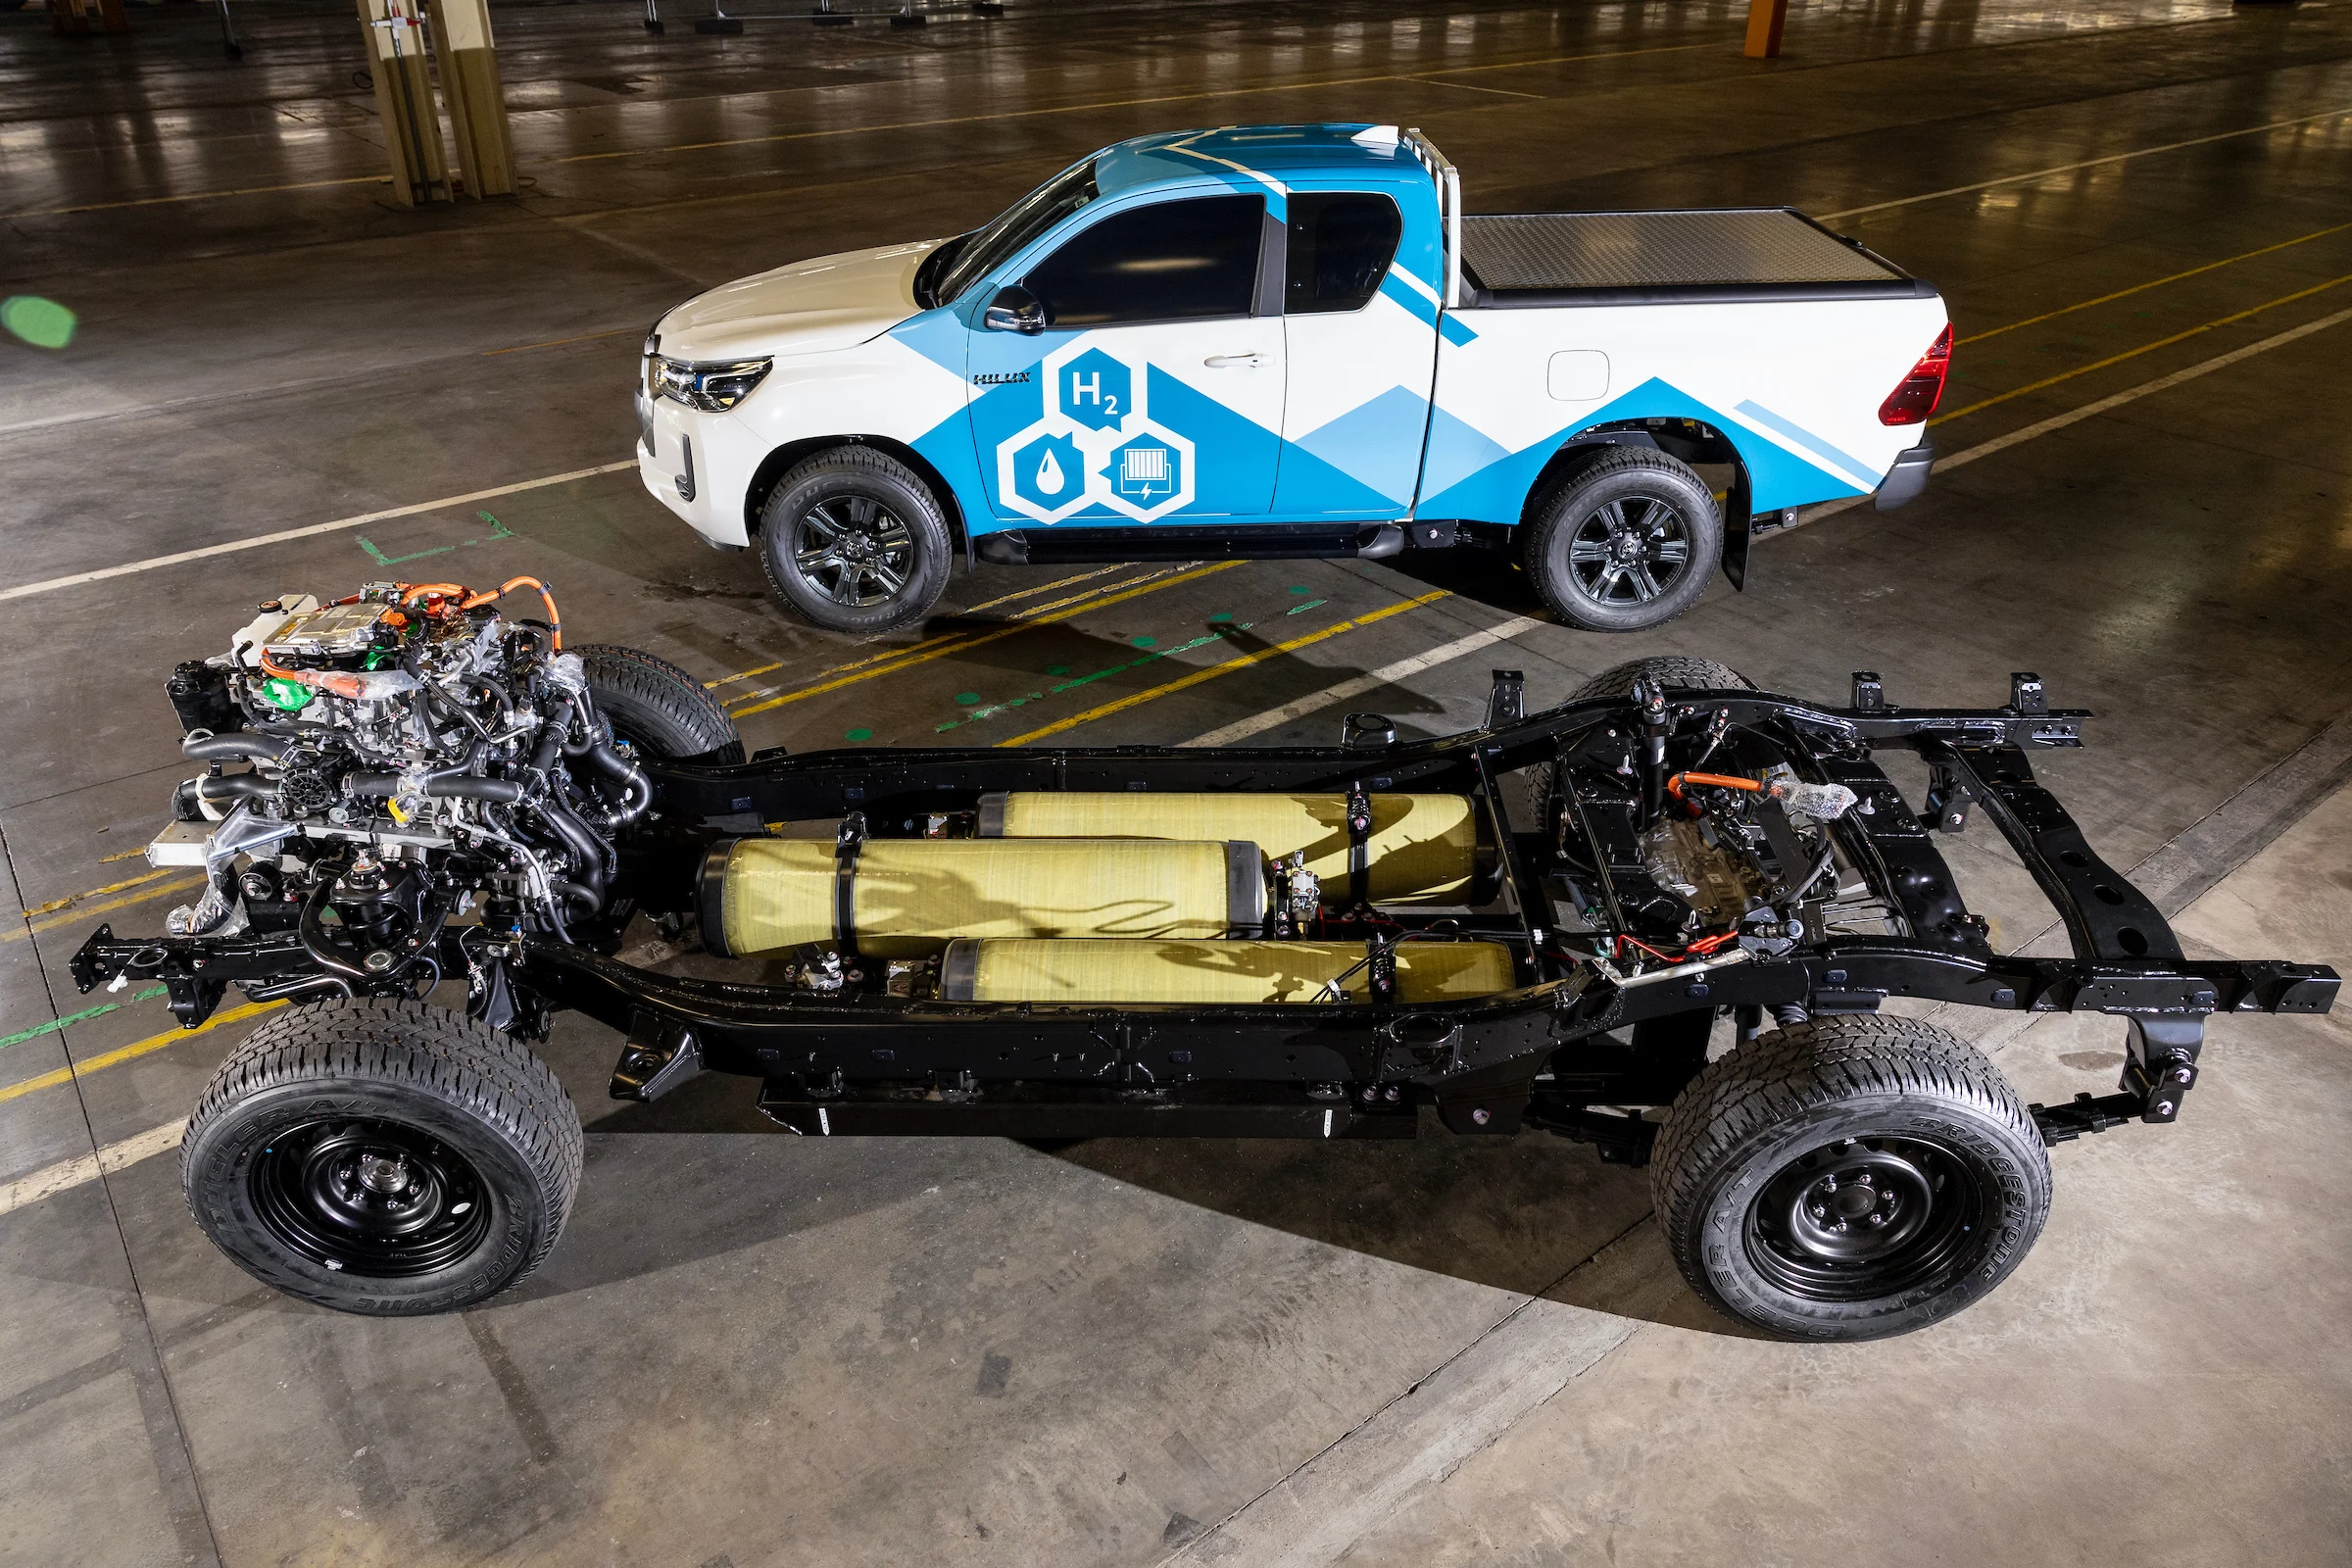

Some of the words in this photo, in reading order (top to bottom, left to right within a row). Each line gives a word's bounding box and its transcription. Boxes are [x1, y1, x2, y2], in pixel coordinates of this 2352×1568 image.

[973, 371, 1031, 384] HILUX
[204, 1106, 290, 1233] DUELER
[1712, 1167, 1754, 1234] A/T
[1910, 1116, 2026, 1282] BRIDGESTONE
[352, 1194, 525, 1312] BRIDGESTONE
[1709, 1244, 1845, 1337] DUELER
